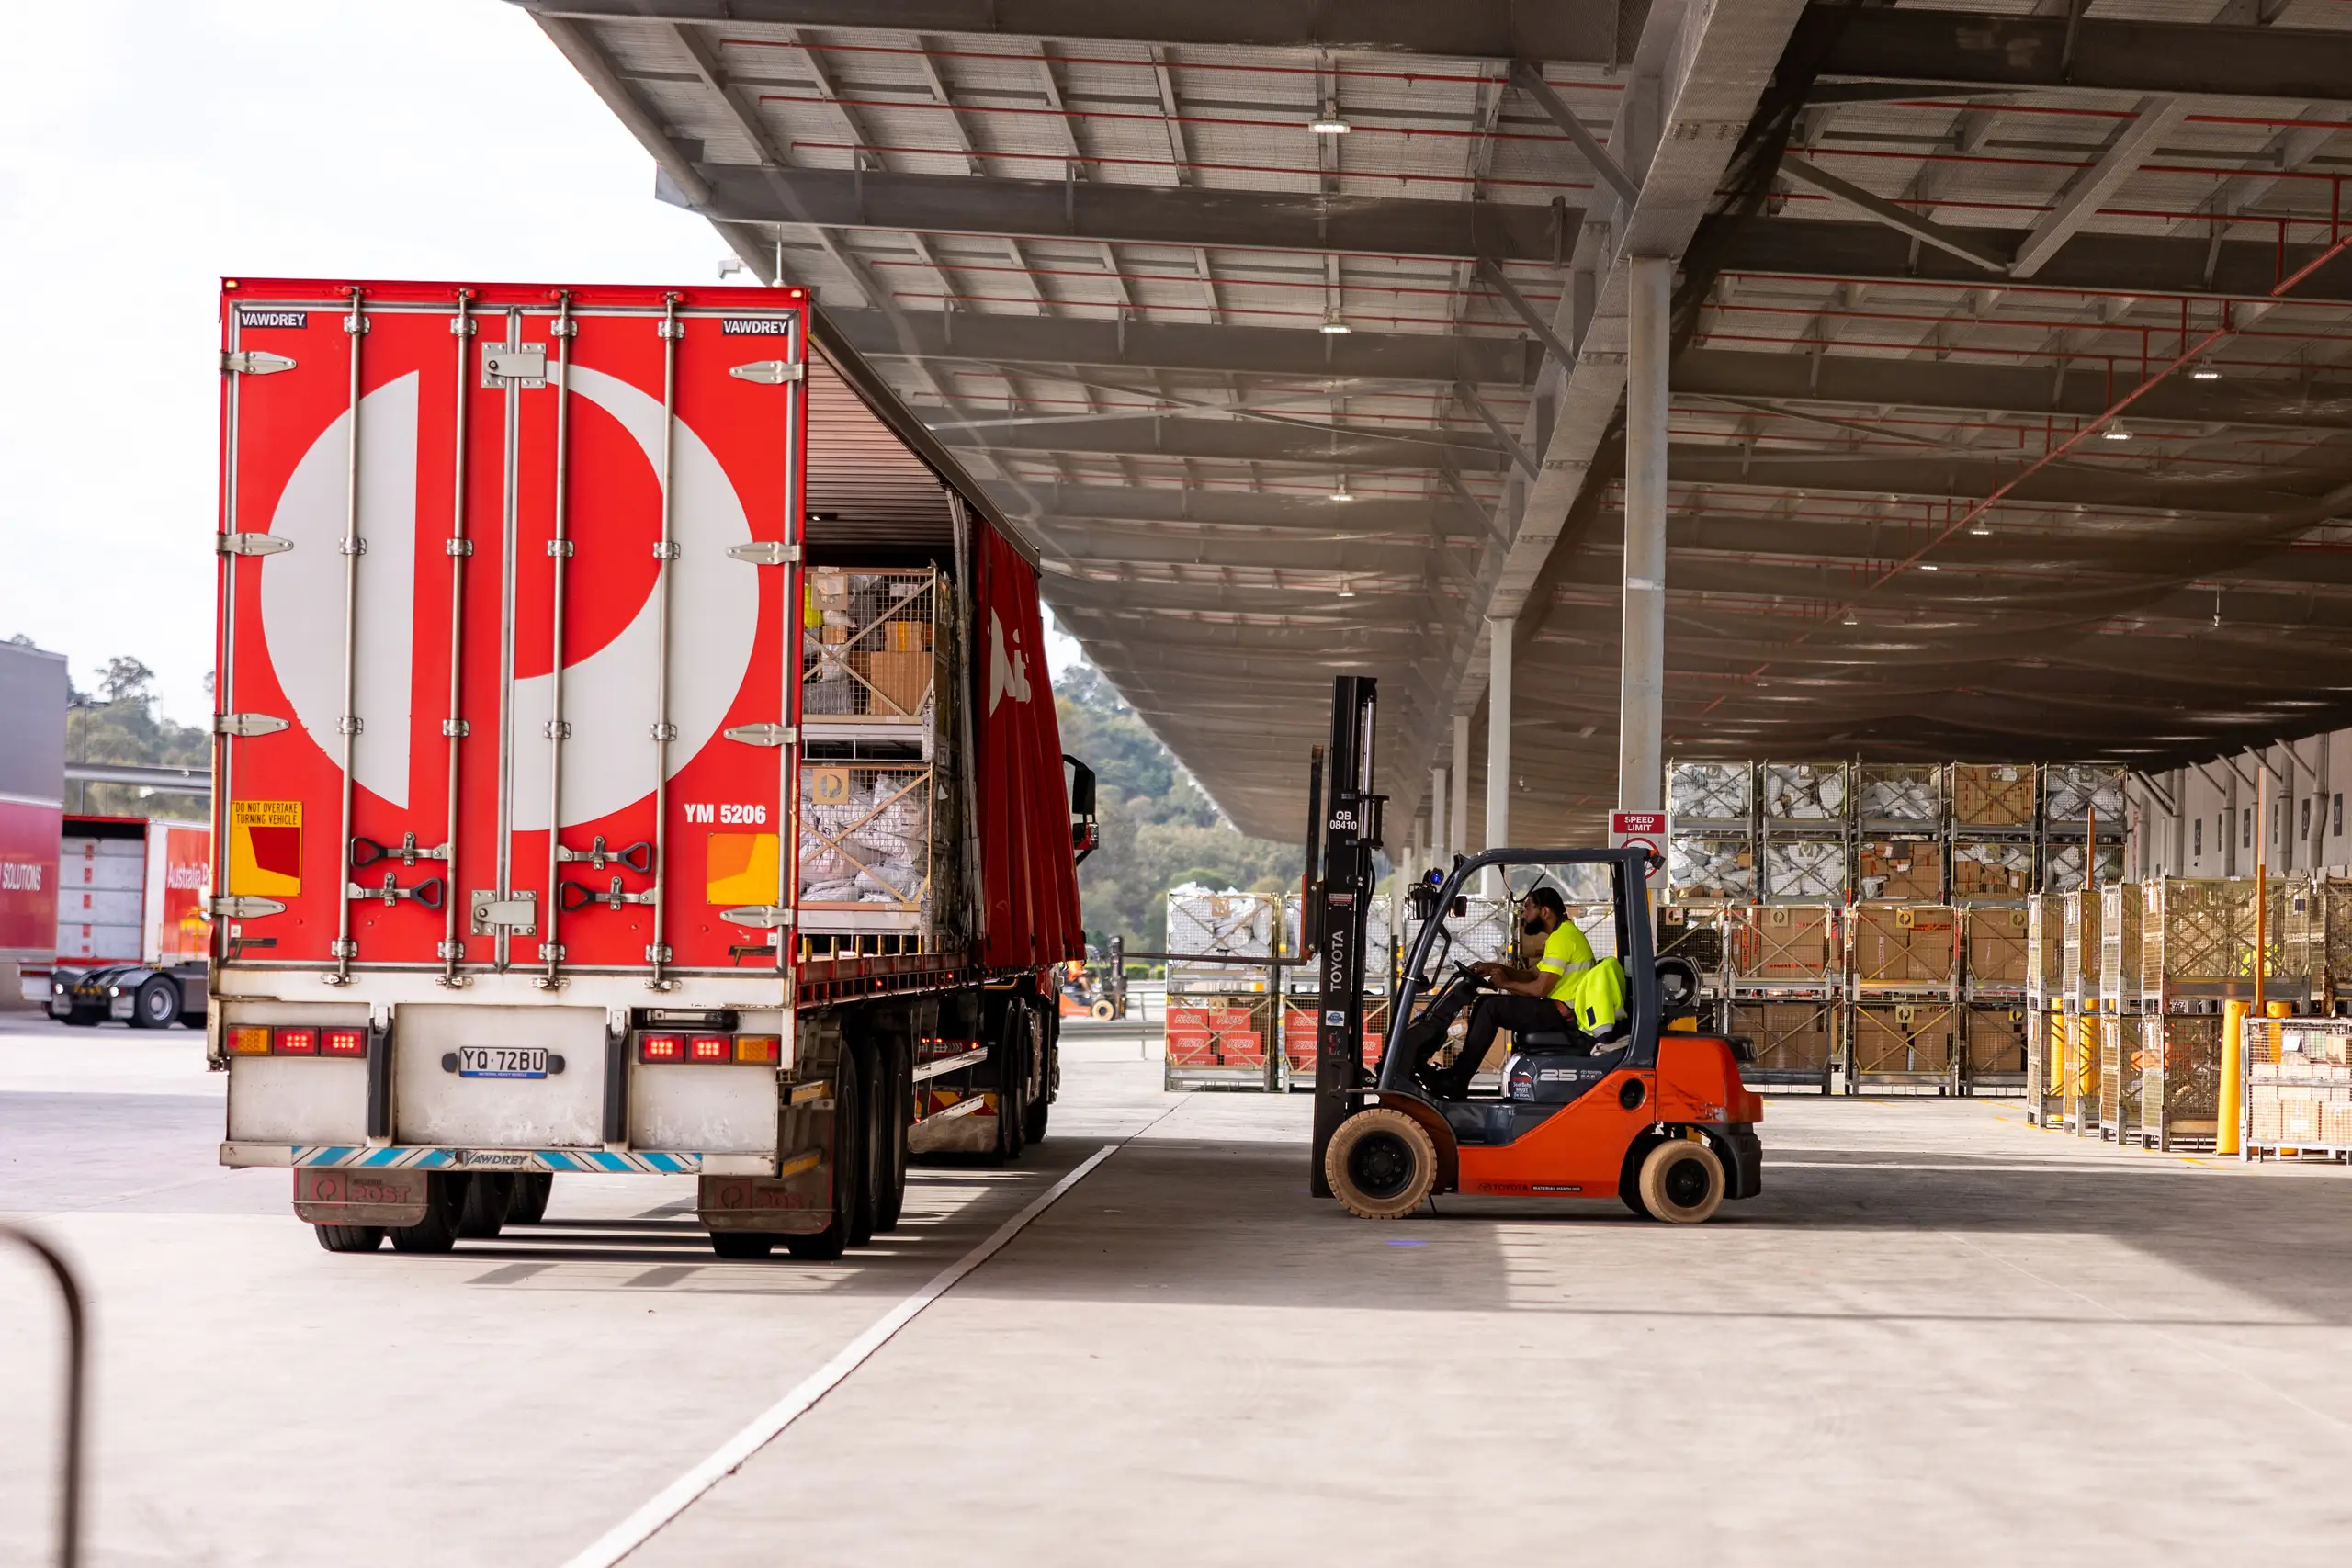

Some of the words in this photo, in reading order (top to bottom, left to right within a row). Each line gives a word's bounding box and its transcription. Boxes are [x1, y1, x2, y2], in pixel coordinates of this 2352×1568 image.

[242, 313, 305, 326] VAWDREY
[723, 321, 787, 333] VAWDREY
[248, 802, 260, 813] NOT
[237, 814, 266, 824] TURNING
[268, 815, 297, 825] VEHICLE
[684, 804, 714, 823] YM
[720, 805, 766, 824] 5206
[1336, 811, 1351, 820] QB
[1624, 816, 1655, 824] SPEED
[1329, 820, 1357, 830] 08410
[3, 863, 42, 890] SOLUTIONS
[167, 862, 201, 889] Australia
[1330, 930, 1344, 992] TOYOTA
[1540, 1069, 1577, 1082] 25
[463, 1151, 529, 1167] VAWDREY
[1493, 1183, 1528, 1192] TOYOTA
